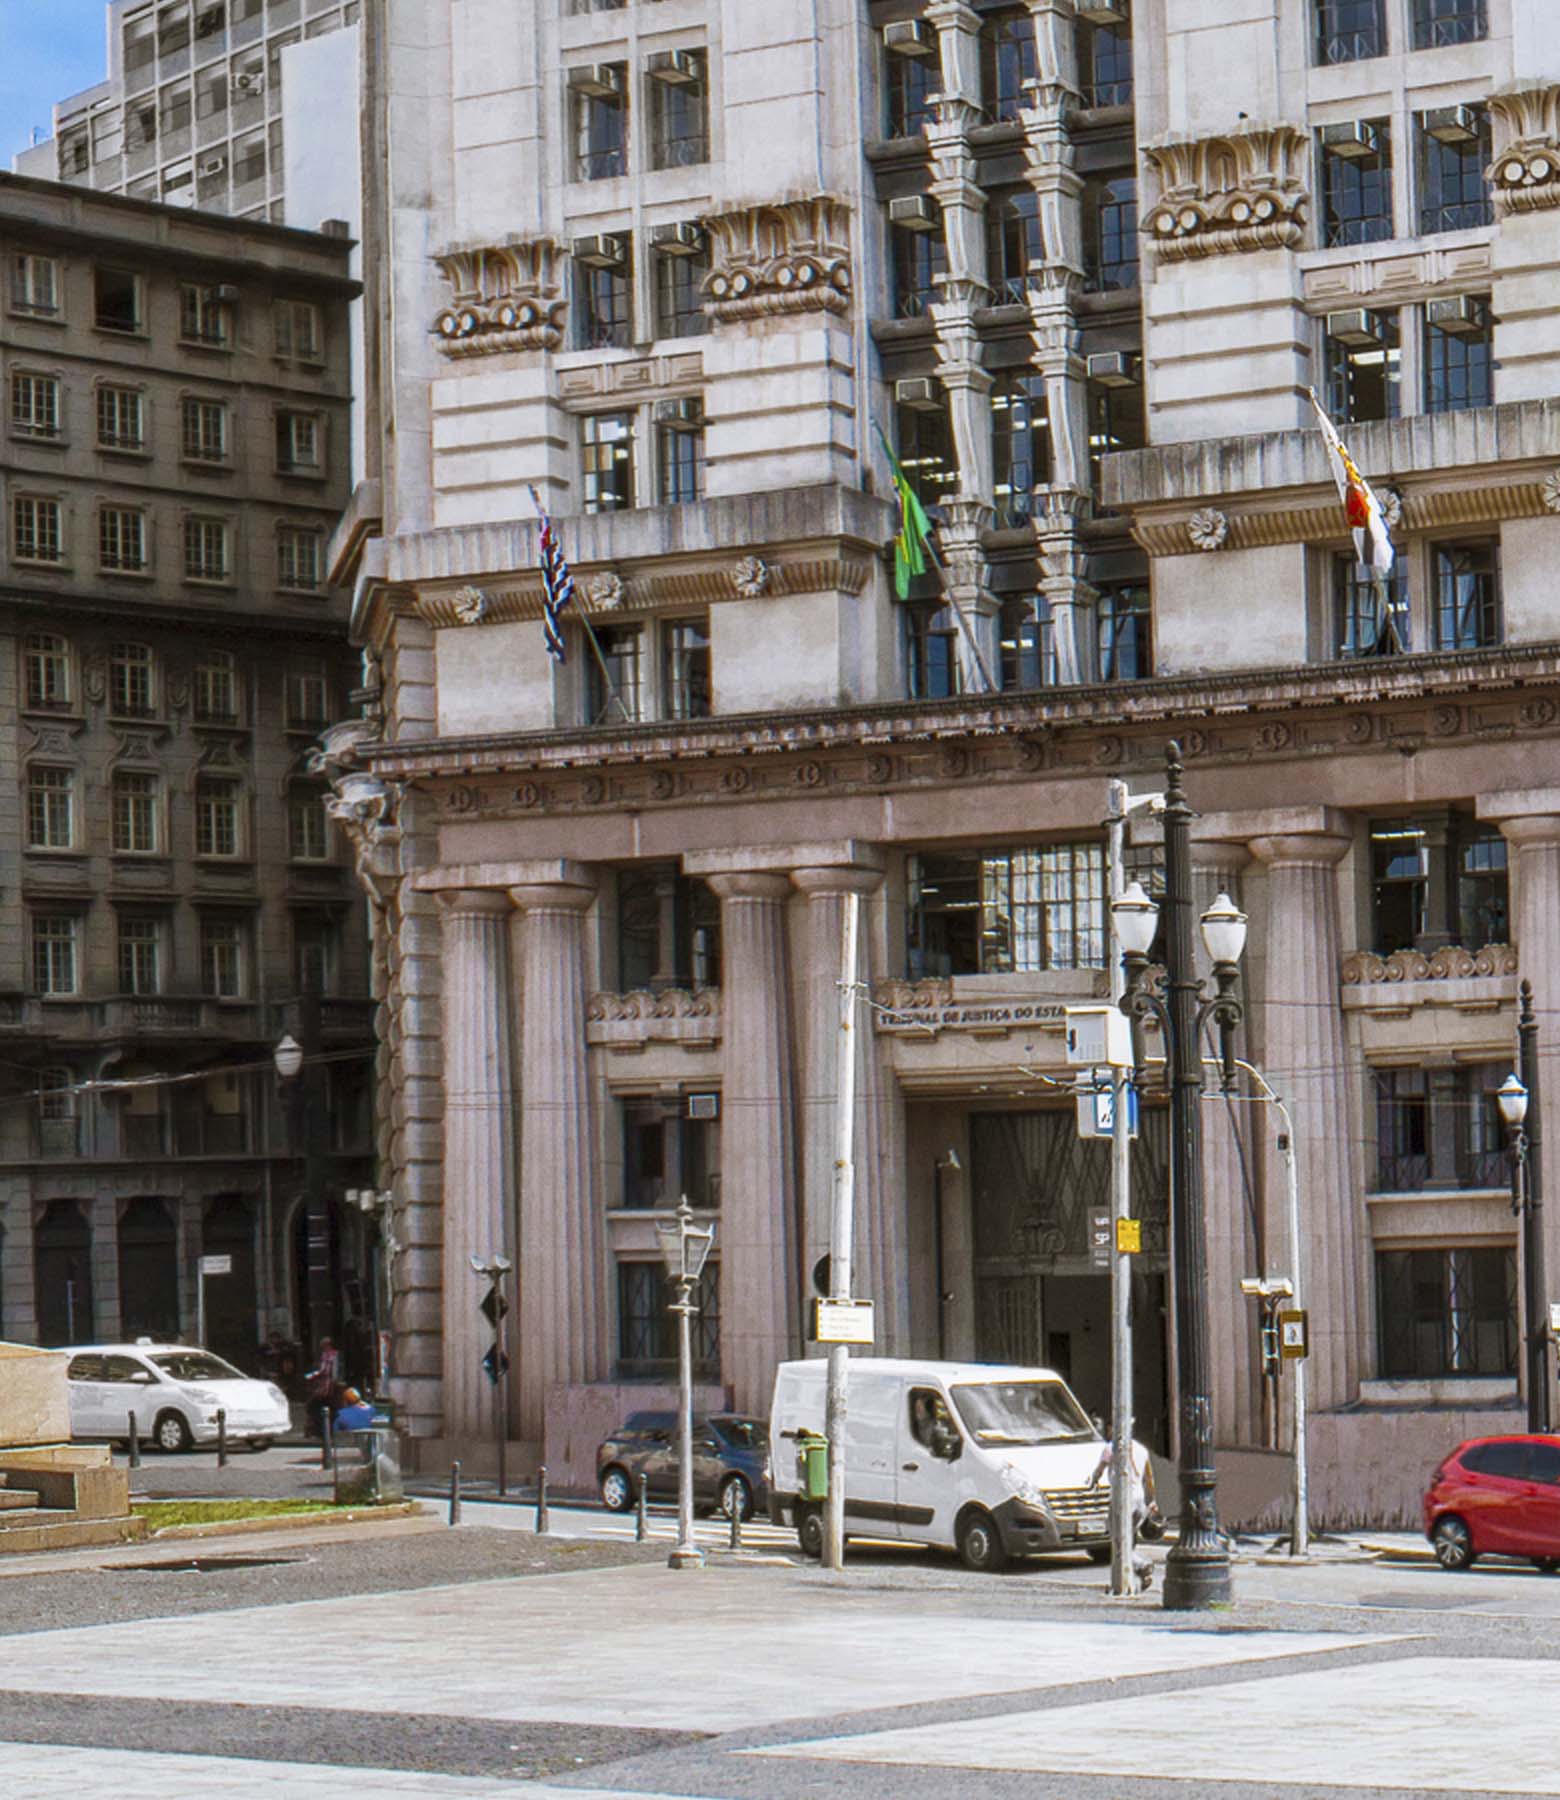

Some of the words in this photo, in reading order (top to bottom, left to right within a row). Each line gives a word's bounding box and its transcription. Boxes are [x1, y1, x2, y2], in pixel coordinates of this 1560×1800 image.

[942, 1011, 959, 1023] DE
[961, 1009, 1011, 1022] JUSTIÇA
[1014, 1007, 1032, 1019] DO
[1035, 1005, 1066, 1018] ESTA
